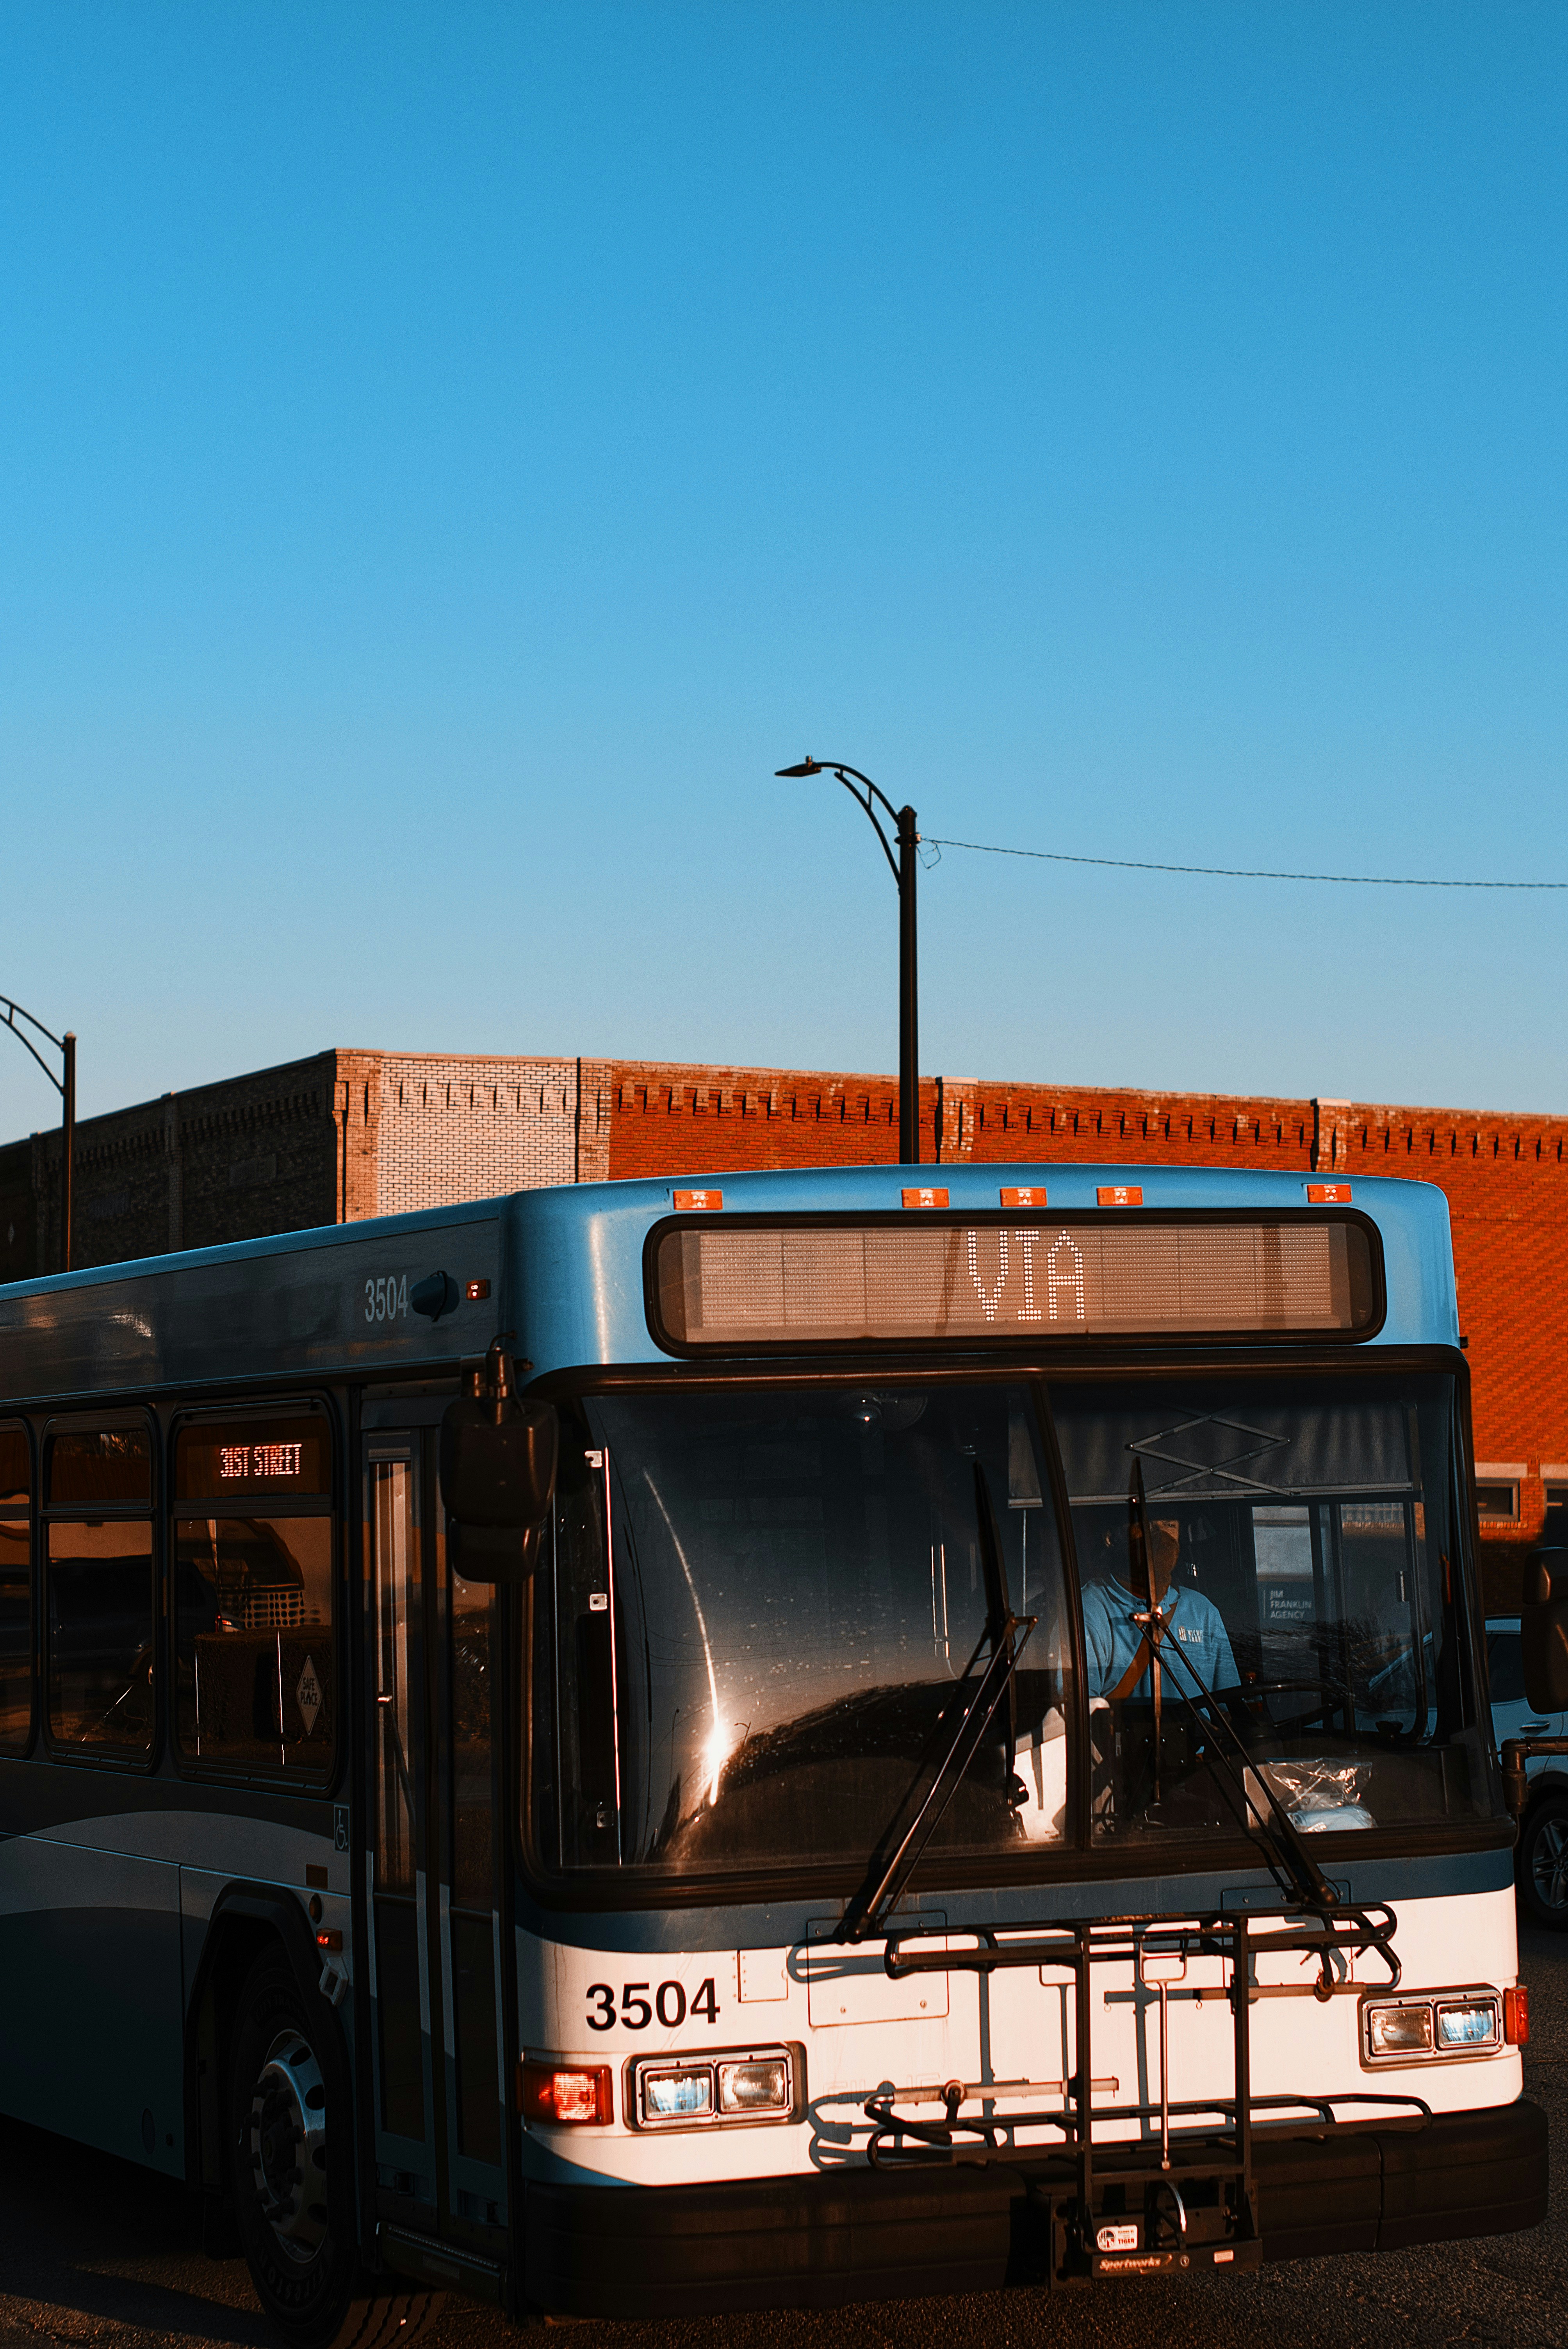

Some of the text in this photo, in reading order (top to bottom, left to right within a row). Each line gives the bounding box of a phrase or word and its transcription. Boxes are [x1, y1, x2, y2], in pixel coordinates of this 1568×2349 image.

[968, 1229, 1085, 1321] VIA
[365, 1274, 409, 1322] 3504
[253, 1444, 302, 1476] STREET
[1270, 1590, 1284, 1600] JIM
[1270, 1600, 1312, 1609] FRANKLIN
[1270, 1611, 1305, 1619] AGENCY
[303, 1676, 315, 1691] SAFE
[300, 1691, 317, 1706] PLACE
[586, 1978, 720, 2031] 3504
